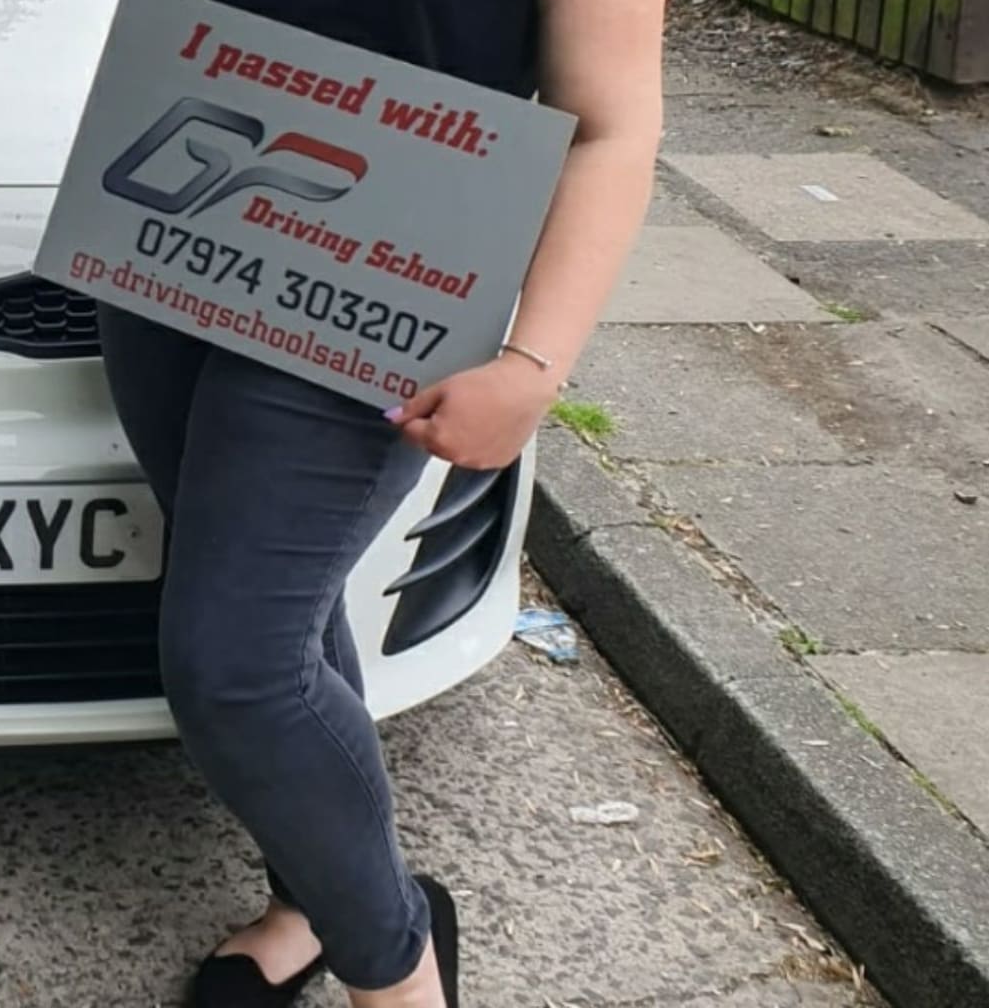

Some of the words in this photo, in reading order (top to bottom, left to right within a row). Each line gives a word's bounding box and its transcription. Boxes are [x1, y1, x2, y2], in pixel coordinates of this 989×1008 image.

[180, 23, 211, 61] I
[204, 41, 376, 115] passed
[379, 102, 499, 158] with:
[102, 96, 369, 218] GP
[136, 218, 263, 295] 07974
[276, 269, 449, 361] 303207
[242, 195, 363, 263] Driving
[364, 239, 479, 300] School
